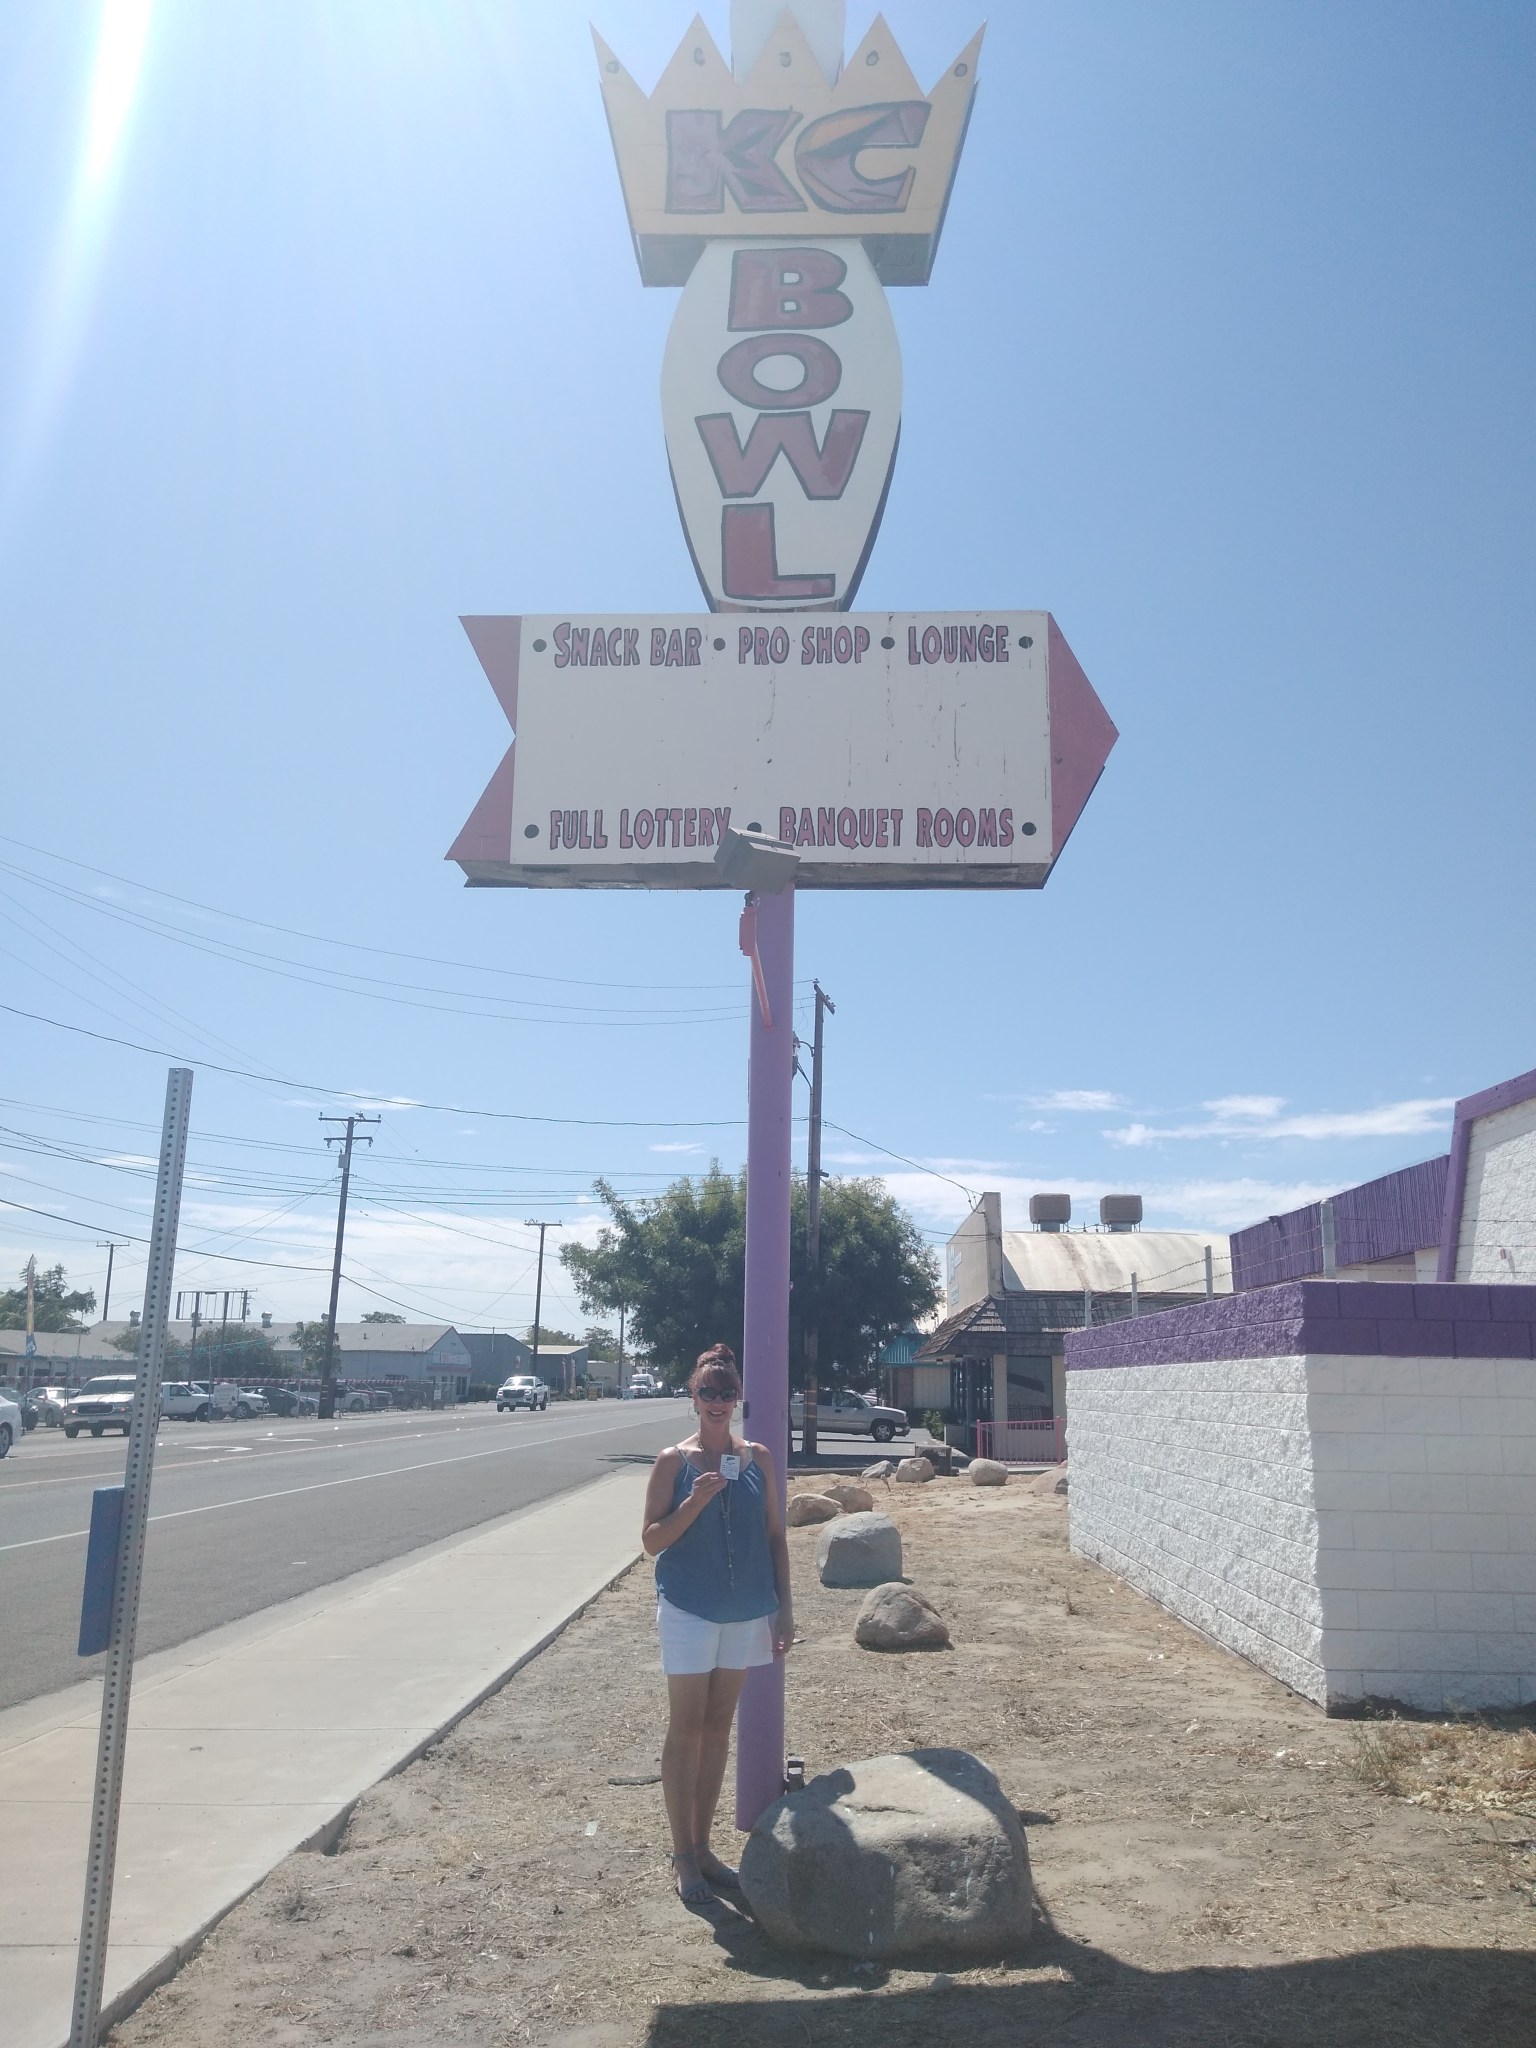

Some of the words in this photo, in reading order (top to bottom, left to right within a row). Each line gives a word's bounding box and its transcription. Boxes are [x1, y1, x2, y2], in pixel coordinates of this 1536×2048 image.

[665, 101, 932, 214] KC
[694, 247, 870, 599] BOWL
[553, 622, 641, 668] SNACK
[650, 627, 702, 667] BAR
[738, 626, 790, 665] PRO
[801, 625, 870, 665] SHOP
[908, 624, 1009, 665] LOUNGE
[550, 810, 608, 850] FULL
[620, 807, 731, 849] LOTTERY
[779, 806, 903, 850] BANQUET
[916, 807, 1014, 848] ROOMS
